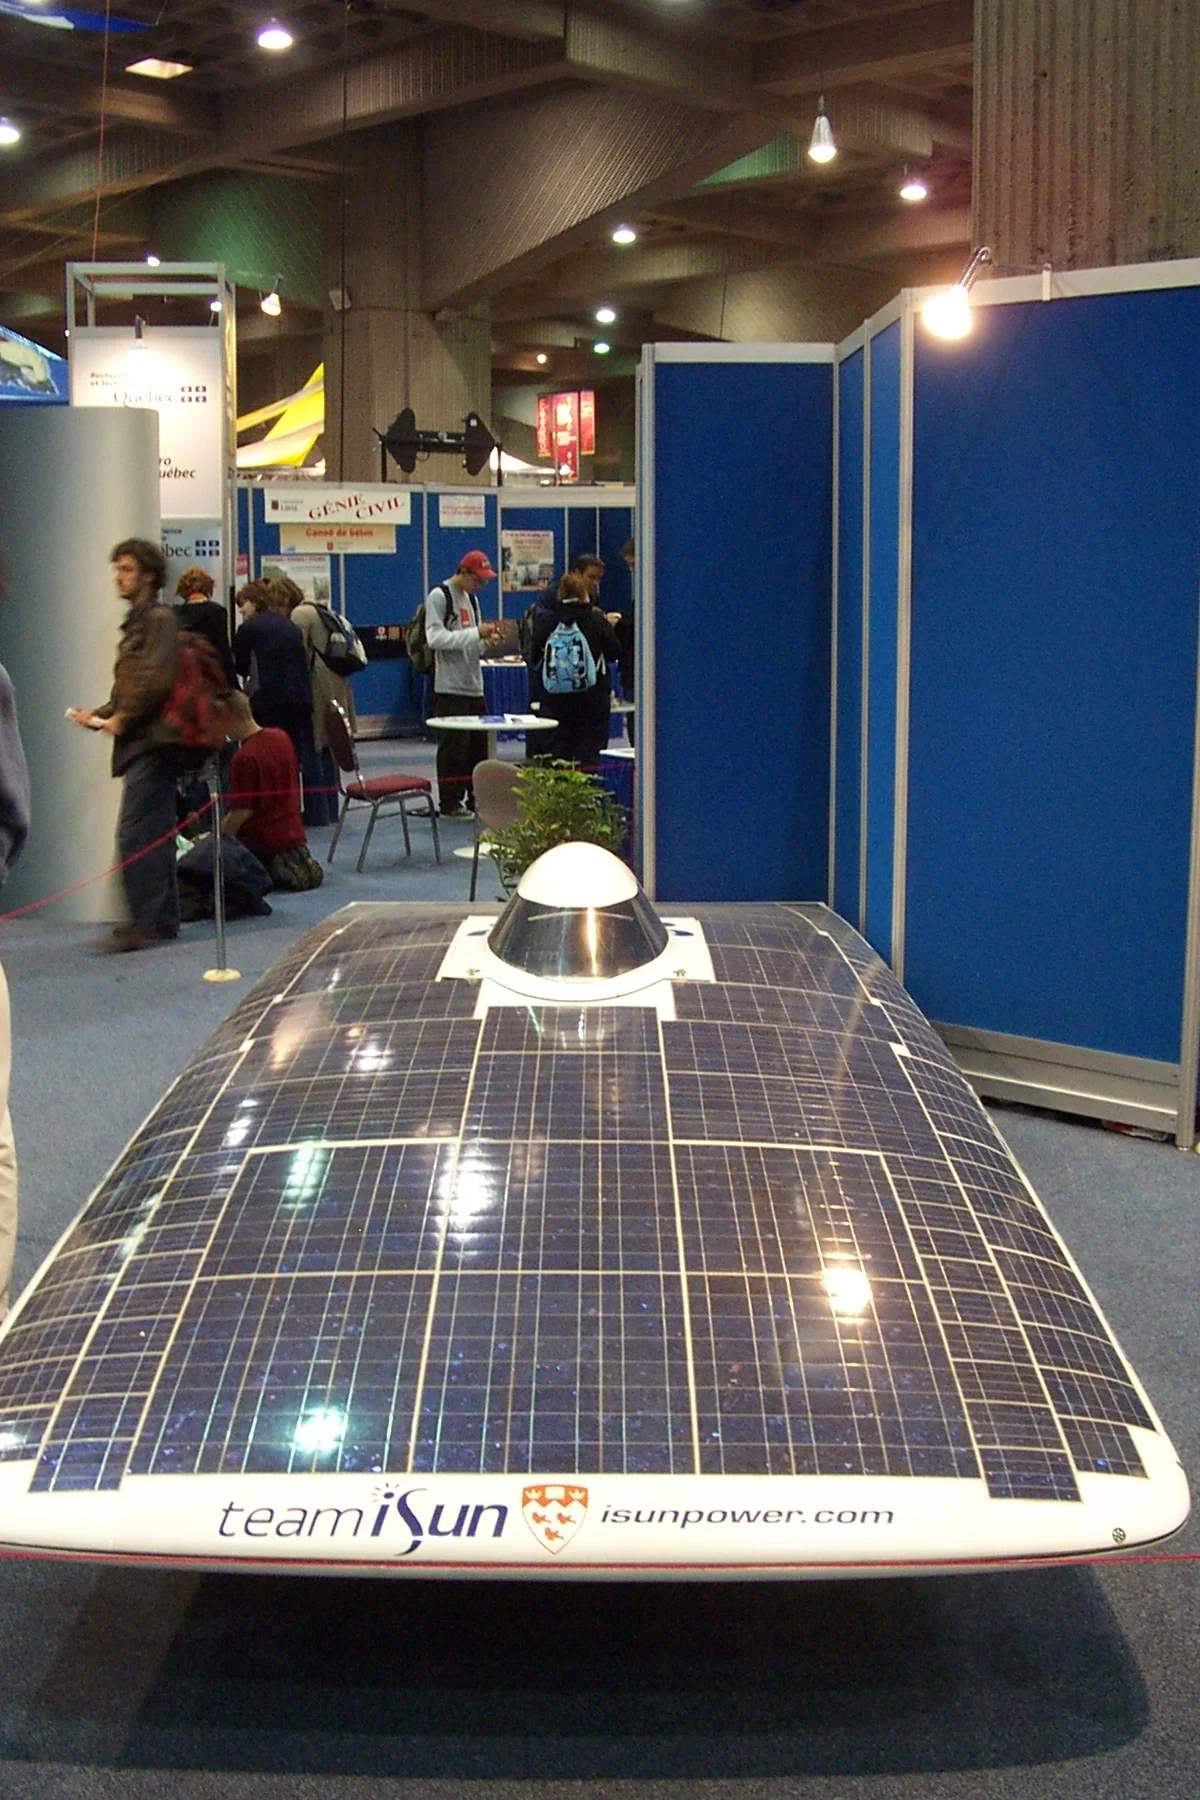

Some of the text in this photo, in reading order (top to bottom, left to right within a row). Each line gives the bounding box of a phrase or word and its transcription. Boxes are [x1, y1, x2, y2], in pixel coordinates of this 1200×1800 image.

[159, 467, 196, 479] uébec
[355, 496, 405, 520] CIVIL
[600, 1504, 895, 1529] isunpower.com
